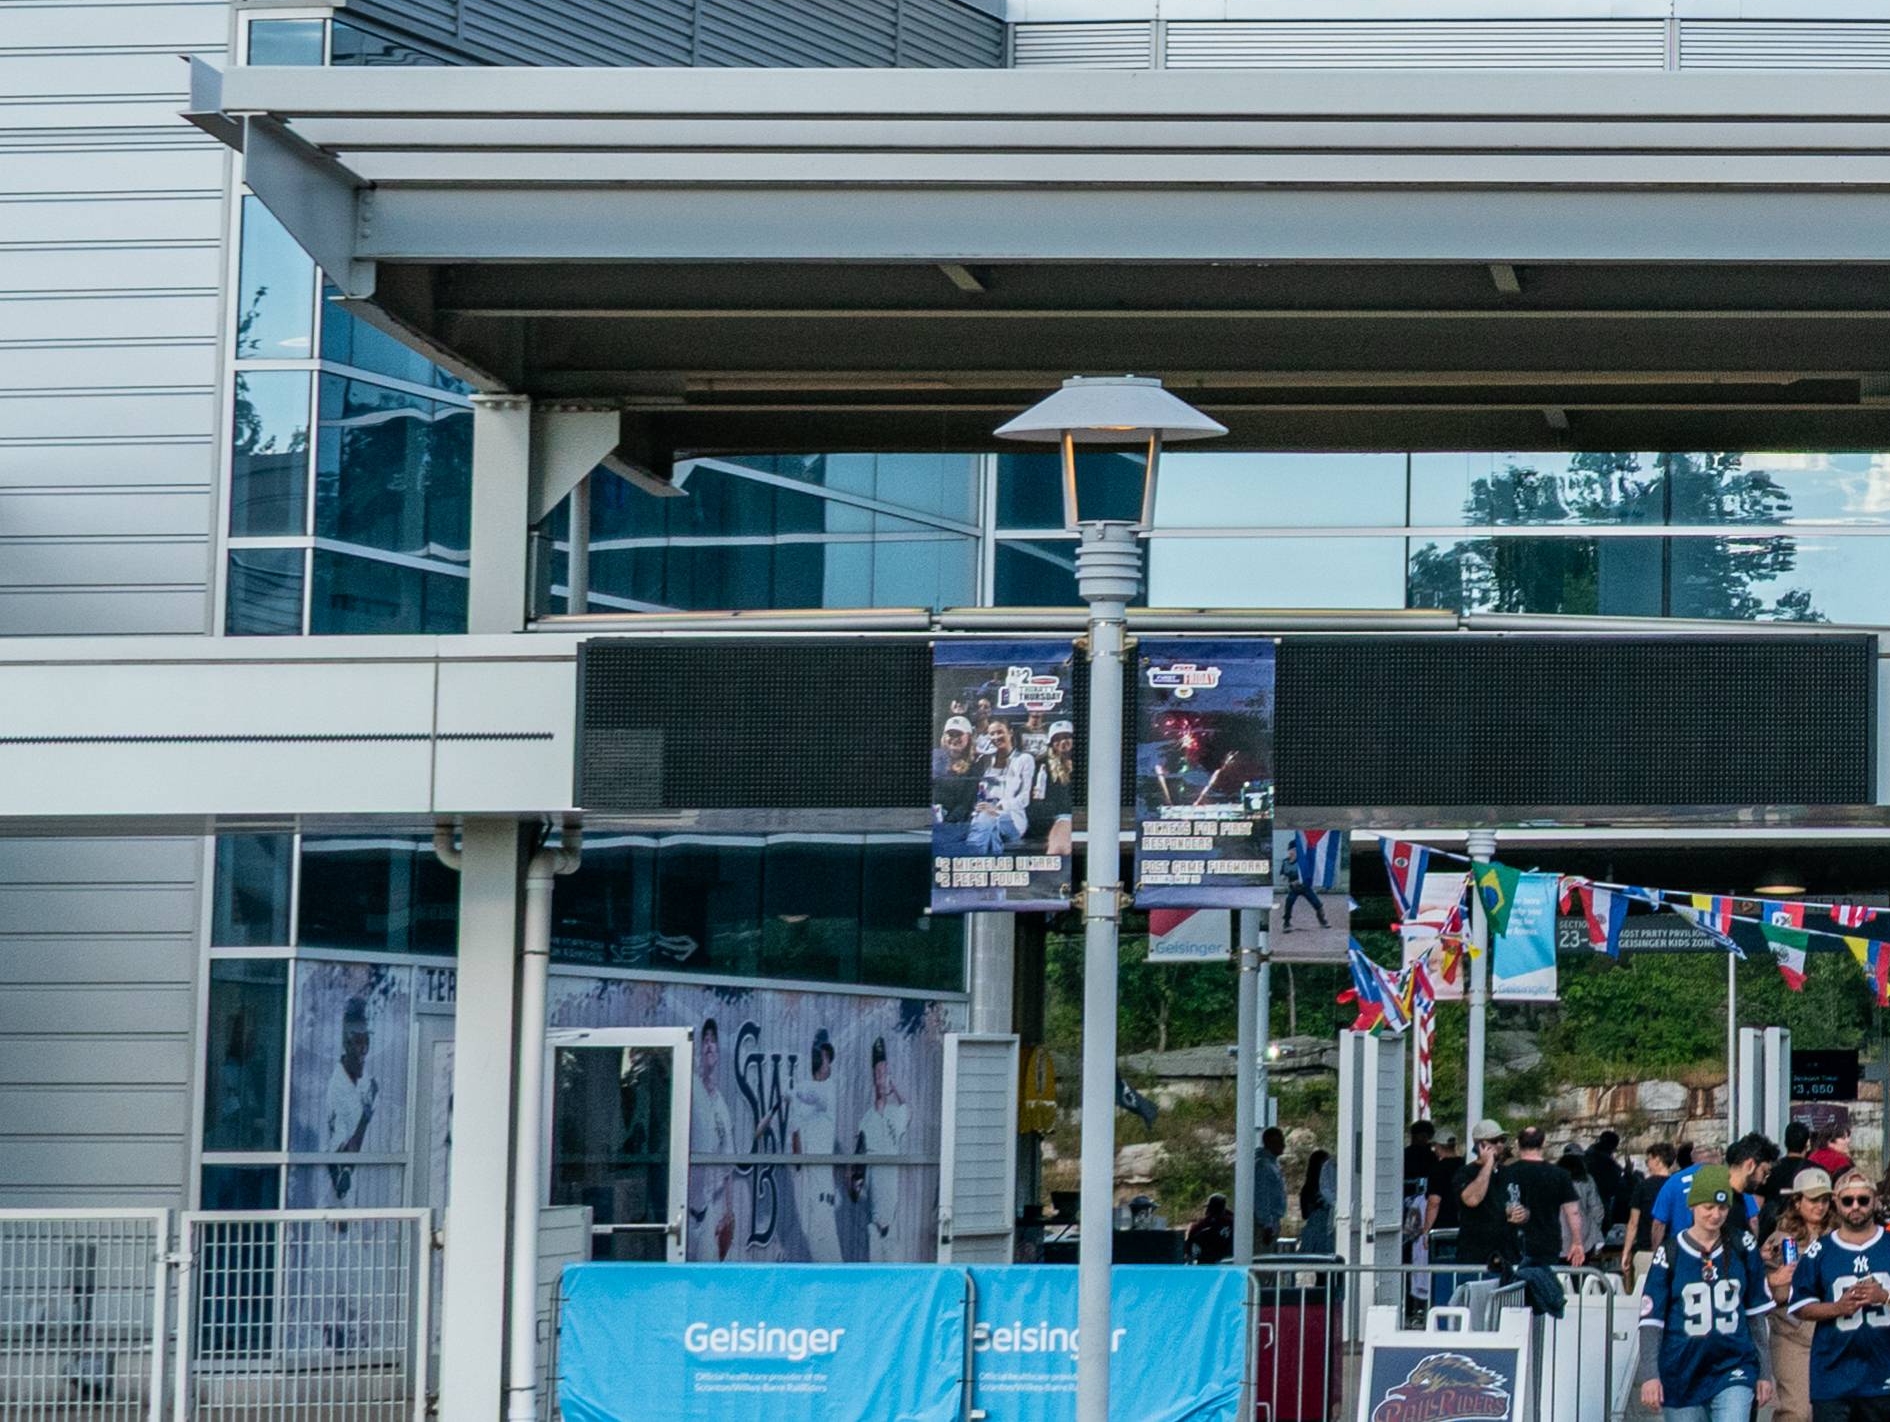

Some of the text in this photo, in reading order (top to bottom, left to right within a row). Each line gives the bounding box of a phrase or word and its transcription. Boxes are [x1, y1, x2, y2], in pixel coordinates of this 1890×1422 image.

[1019, 692, 1062, 701] THURSDAY
[1143, 821, 1253, 836] TICKETS FOR FIRST
[1142, 837, 1213, 851] RESPONDERS
[952, 857, 1014, 872] MICHELOB
[1141, 860, 1270, 875] POST GAME FIREWORKS
[952, 872, 988, 887] PEPSI
[990, 872, 1030, 887] POURS
[1559, 920, 1589, 929] SECTIO
[1640, 930, 1667, 938] PARTY
[1155, 940, 1223, 957] Geisinger
[1618, 938, 1716, 948] GEISINGER KIDS ZONE
[1682, 1278, 1742, 1337] 99
[684, 1321, 846, 1361] Geisinger
[973, 1321, 1127, 1361] Geisinr
